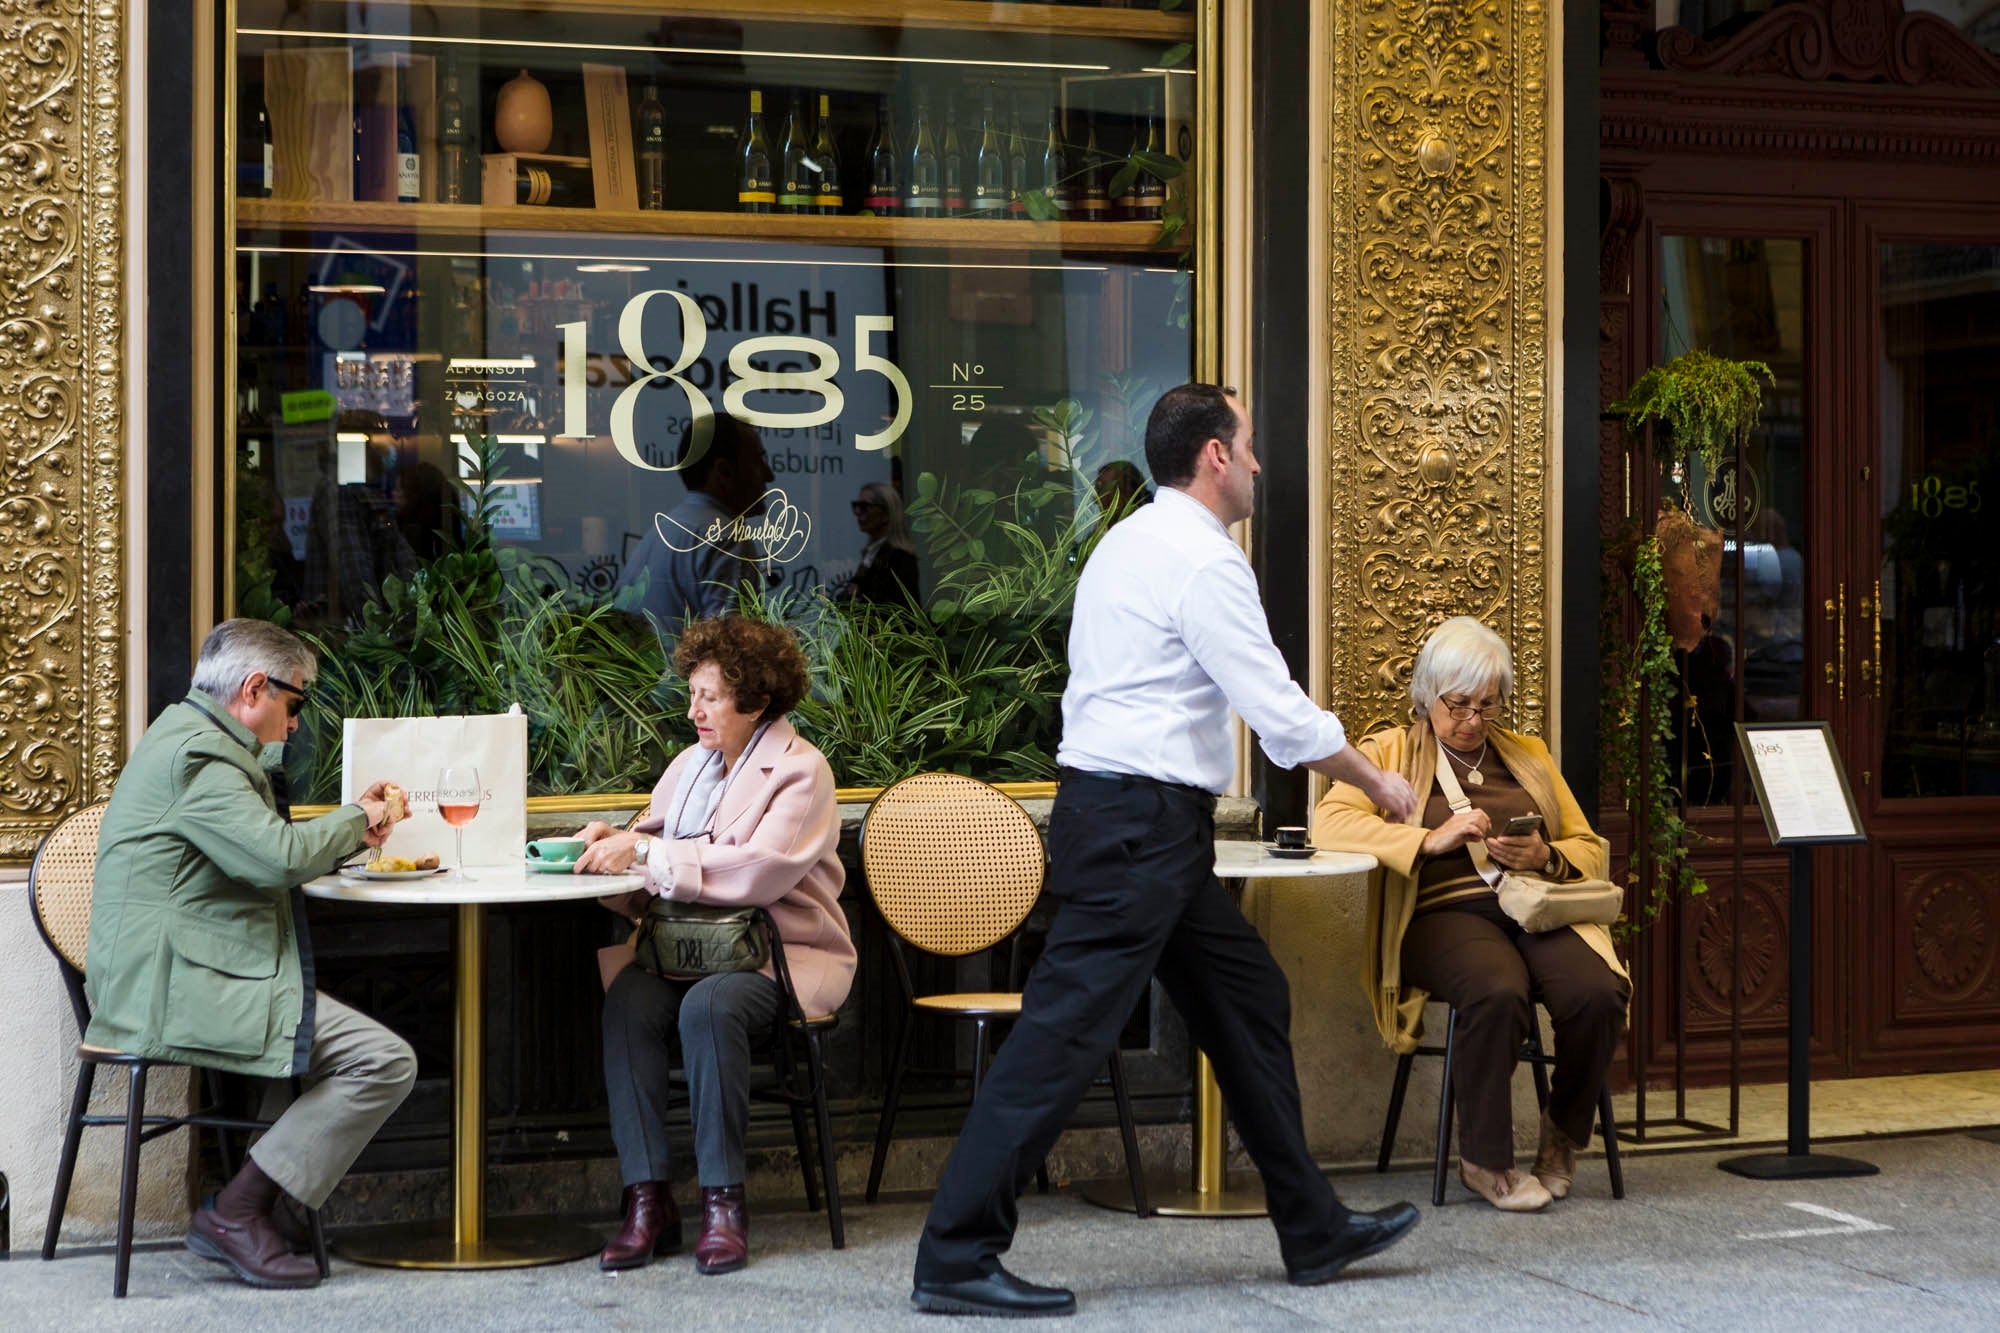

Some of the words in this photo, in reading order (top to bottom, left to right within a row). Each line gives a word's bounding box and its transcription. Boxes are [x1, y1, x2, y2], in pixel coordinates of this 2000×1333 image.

[445, 364, 515, 375] ALFONSO
[555, 289, 913, 471] 1885
[445, 391, 526, 402] ZARAGOZA
[952, 394, 985, 411] 25
[1912, 476, 1981, 518] 1885
